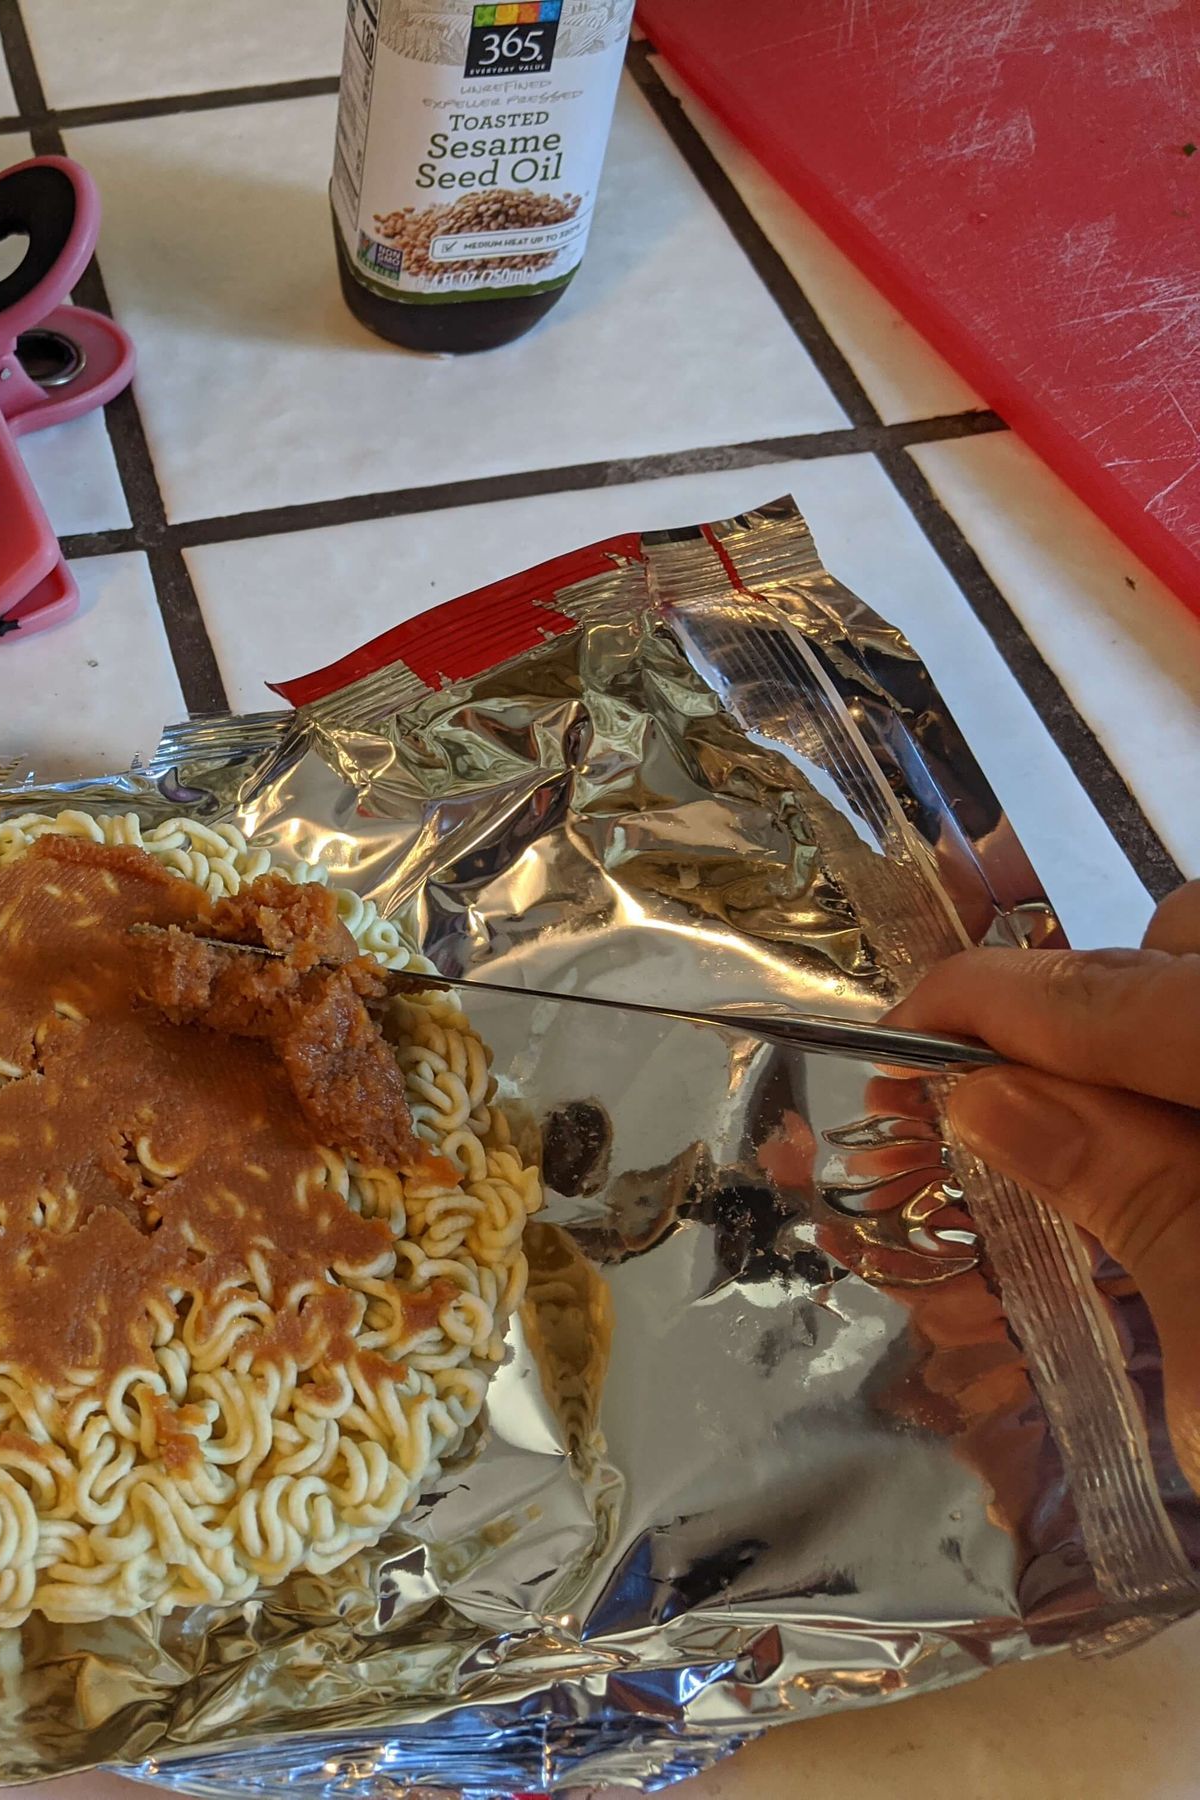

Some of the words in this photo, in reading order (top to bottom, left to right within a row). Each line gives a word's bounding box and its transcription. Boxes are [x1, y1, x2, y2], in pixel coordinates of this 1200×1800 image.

[478, 27, 544, 65] 365
[470, 66, 514, 75] EVERYDAY
[518, 64, 546, 72] VALUE
[460, 80, 552, 95] UNREFINED
[506, 90, 583, 105] PRESSED
[427, 133, 561, 159] Sesame
[415, 159, 498, 189] Seed
[510, 153, 562, 183] Oil
[464, 240, 502, 250] MEDIUM
[504, 238, 528, 247] HEAT
[531, 237, 544, 245] UP
[545, 234, 557, 242] TO
